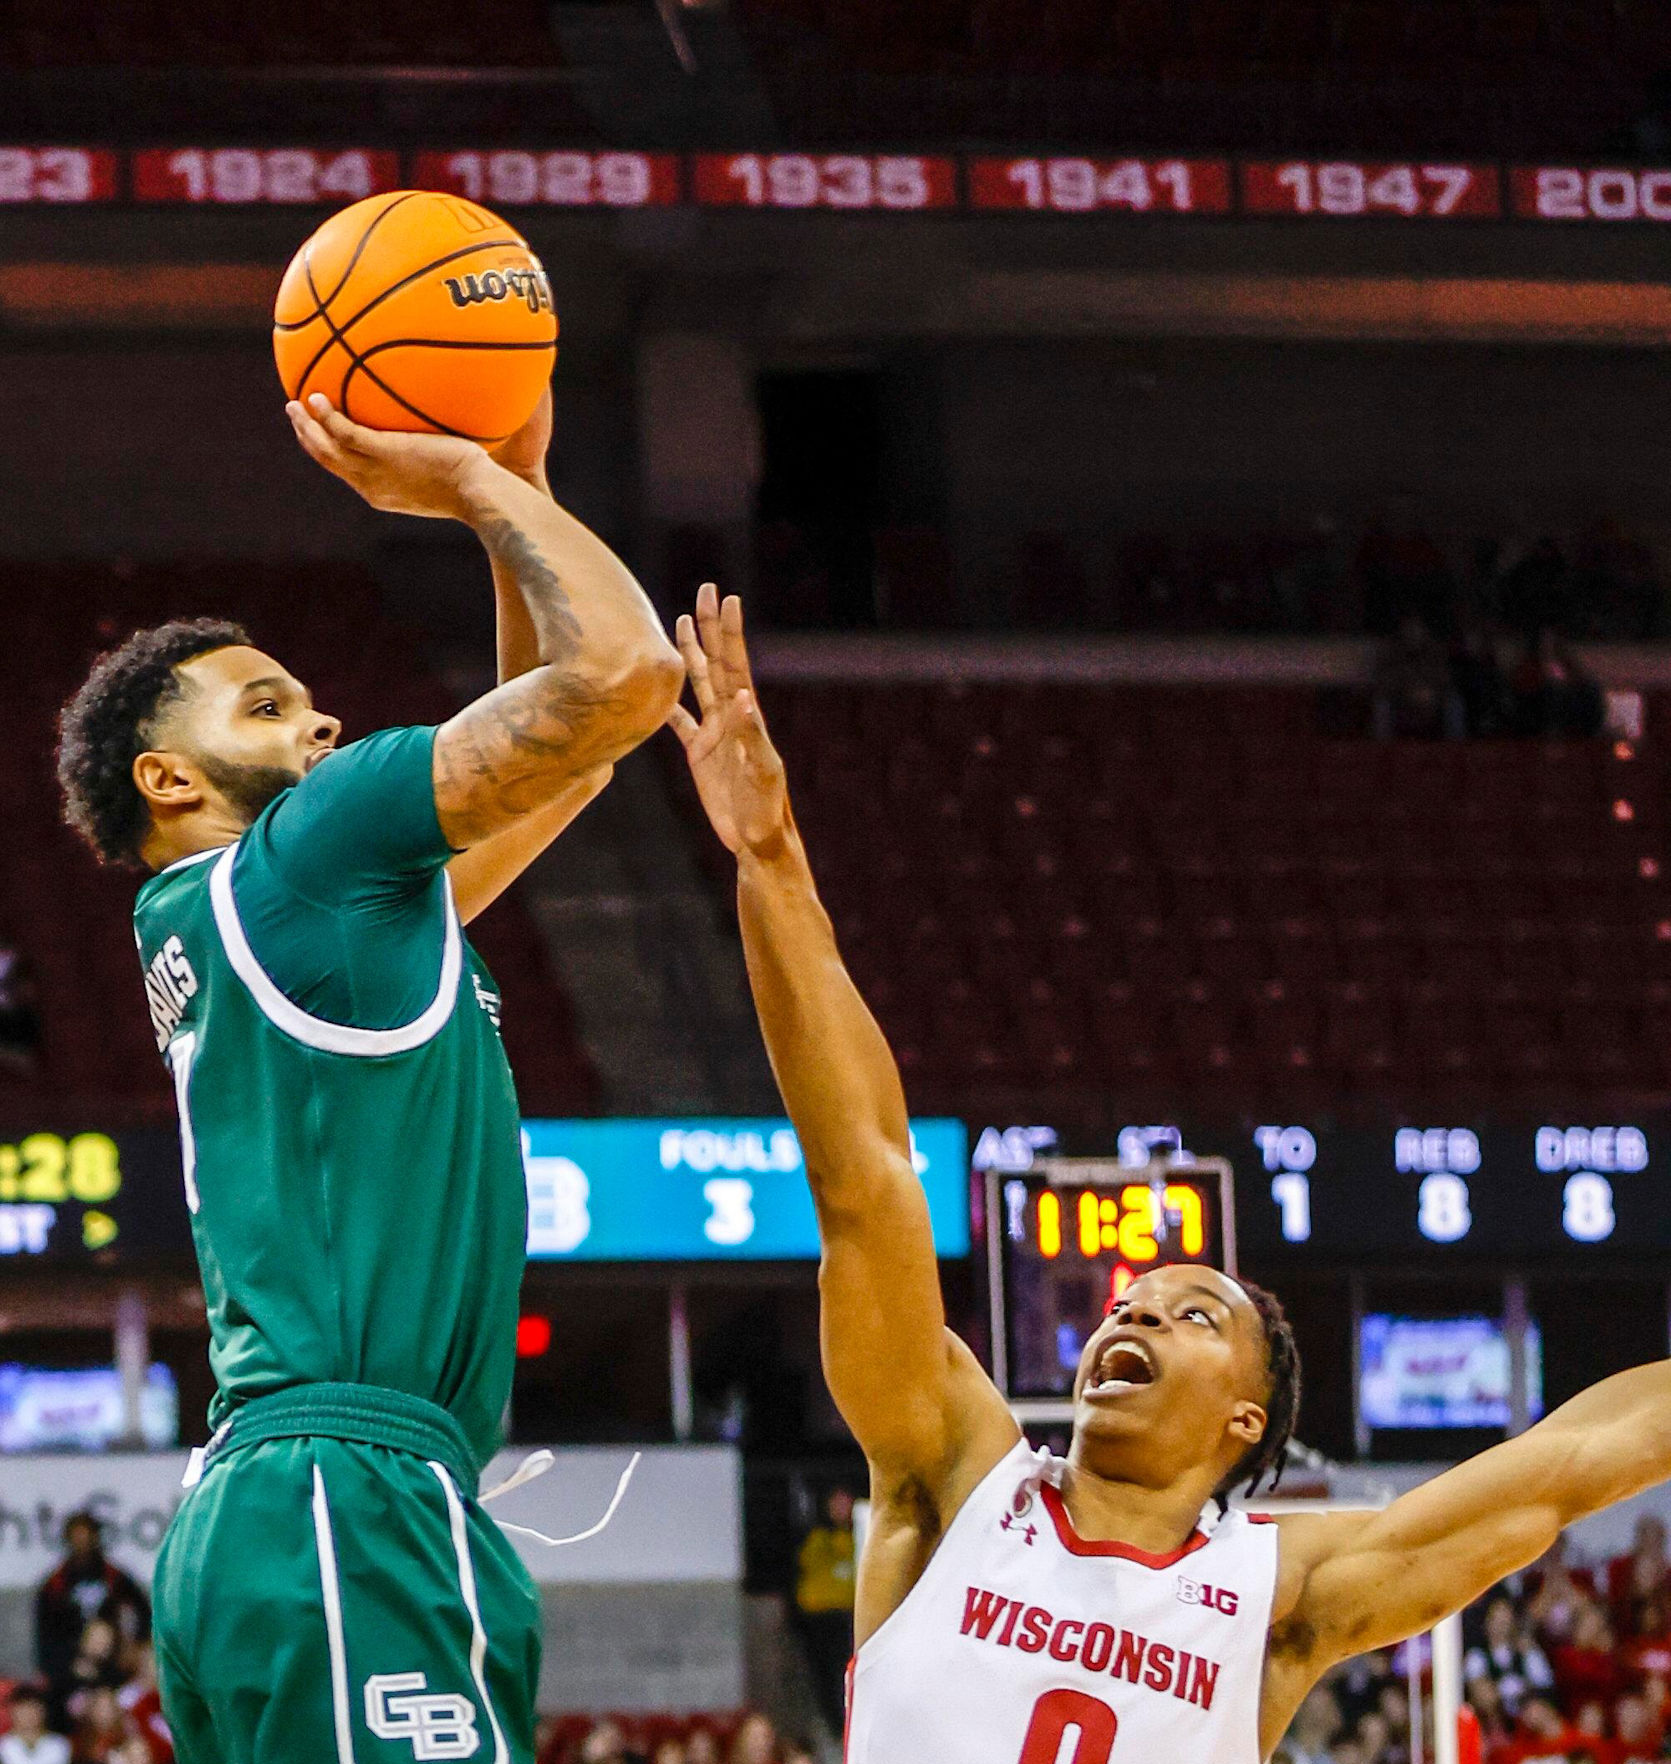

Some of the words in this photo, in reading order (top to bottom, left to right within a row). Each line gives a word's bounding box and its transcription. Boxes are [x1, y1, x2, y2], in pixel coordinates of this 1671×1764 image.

[169, 149, 372, 200] 1924
[728, 154, 930, 208] 1935
[1008, 159, 1192, 211] 1941
[1278, 163, 1471, 216] 1947
[660, 1129, 803, 1172] FOULS
[1254, 1125, 1317, 1172] TO
[1393, 1126, 1483, 1174] REB
[702, 1177, 756, 1246] 3
[1271, 1171, 1311, 1243] 1
[1418, 1172, 1472, 1243] 8
[1562, 1171, 1616, 1243] 8
[959, 1586, 1221, 1712] WISCONSIN
